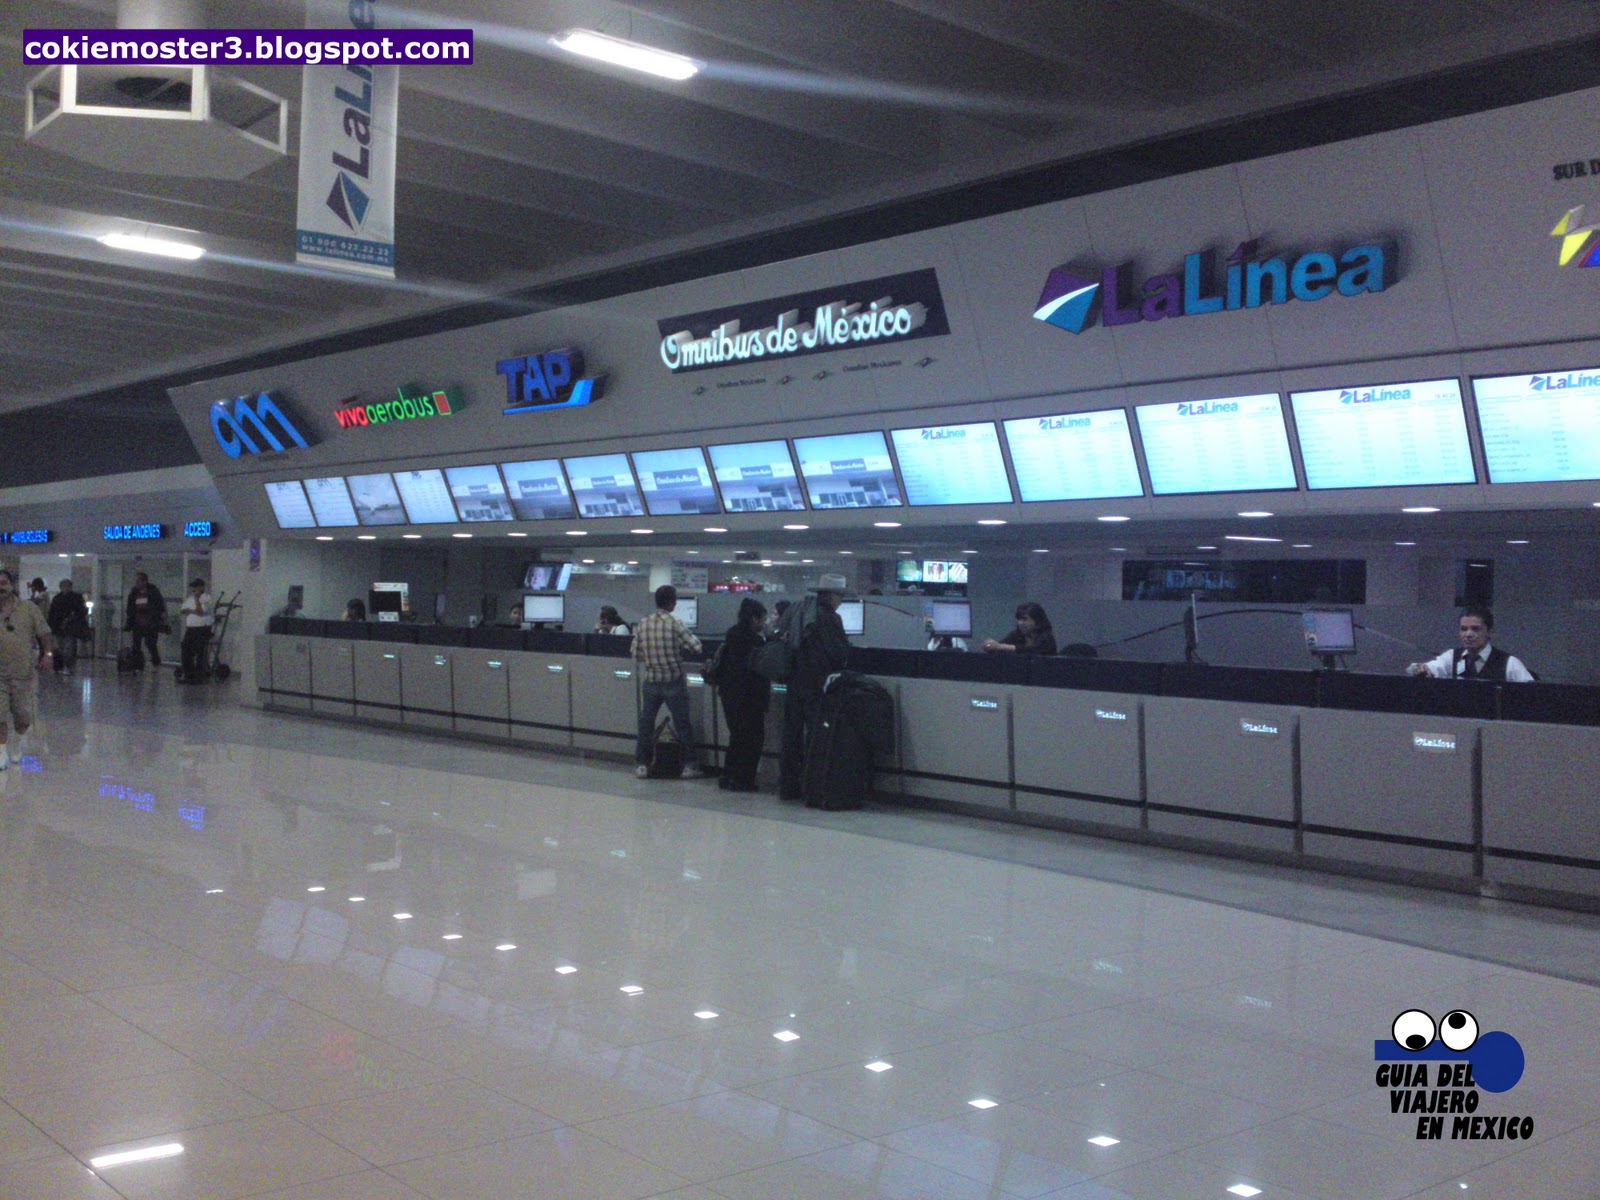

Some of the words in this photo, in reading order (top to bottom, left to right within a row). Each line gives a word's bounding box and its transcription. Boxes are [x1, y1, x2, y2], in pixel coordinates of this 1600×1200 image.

[1553, 162, 1587, 181] SUR
[1590, 158, 1600, 176] D
[660, 323, 765, 370] Omnibus
[766, 313, 798, 355] de
[496, 351, 571, 404] TAP
[103, 525, 123, 540] SALIDA
[123, 525, 132, 539] DE
[132, 523, 161, 539] ANDENES
[184, 521, 212, 537] ACCESO
